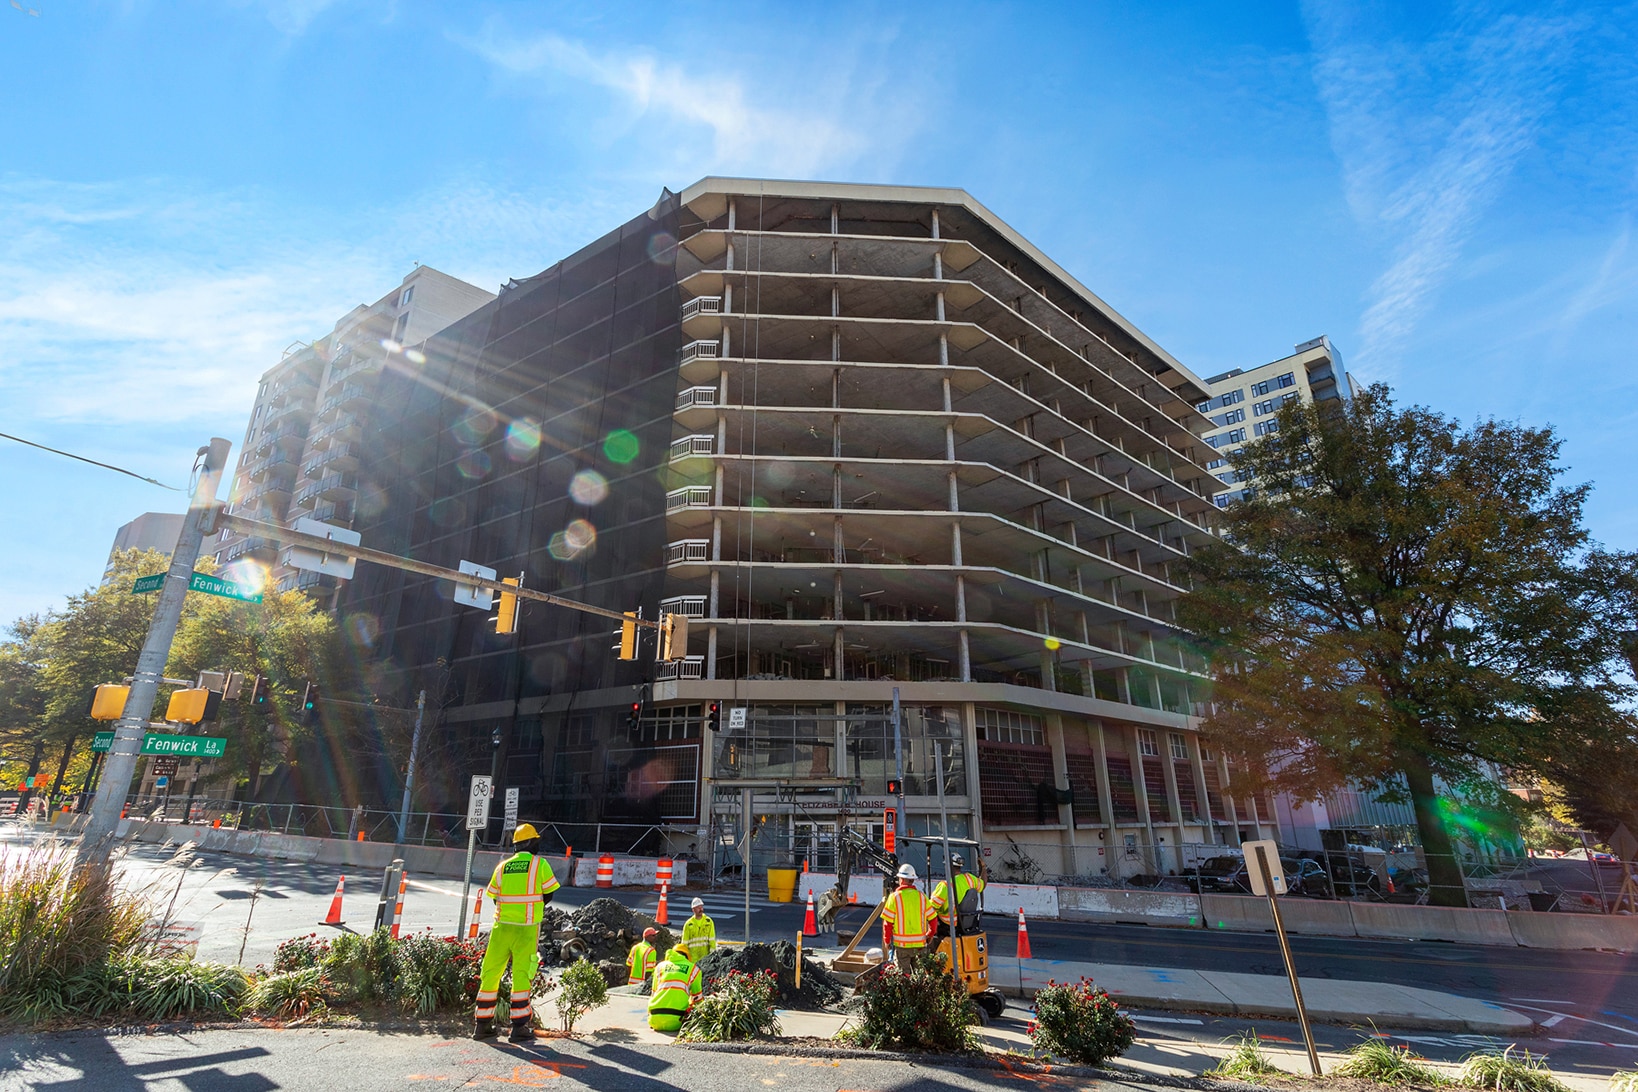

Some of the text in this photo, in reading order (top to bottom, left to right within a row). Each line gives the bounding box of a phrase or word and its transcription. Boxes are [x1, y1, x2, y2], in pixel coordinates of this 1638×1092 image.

[135, 578, 159, 591] Second
[193, 577, 238, 596] Fenwick
[93, 736, 112, 748] Second
[146, 737, 217, 752] Fenwick La
[475, 799, 484, 807] USE
[474, 808, 483, 816] PED
[469, 817, 485, 826] SIGNAL
[874, 860, 893, 876] DEERE
